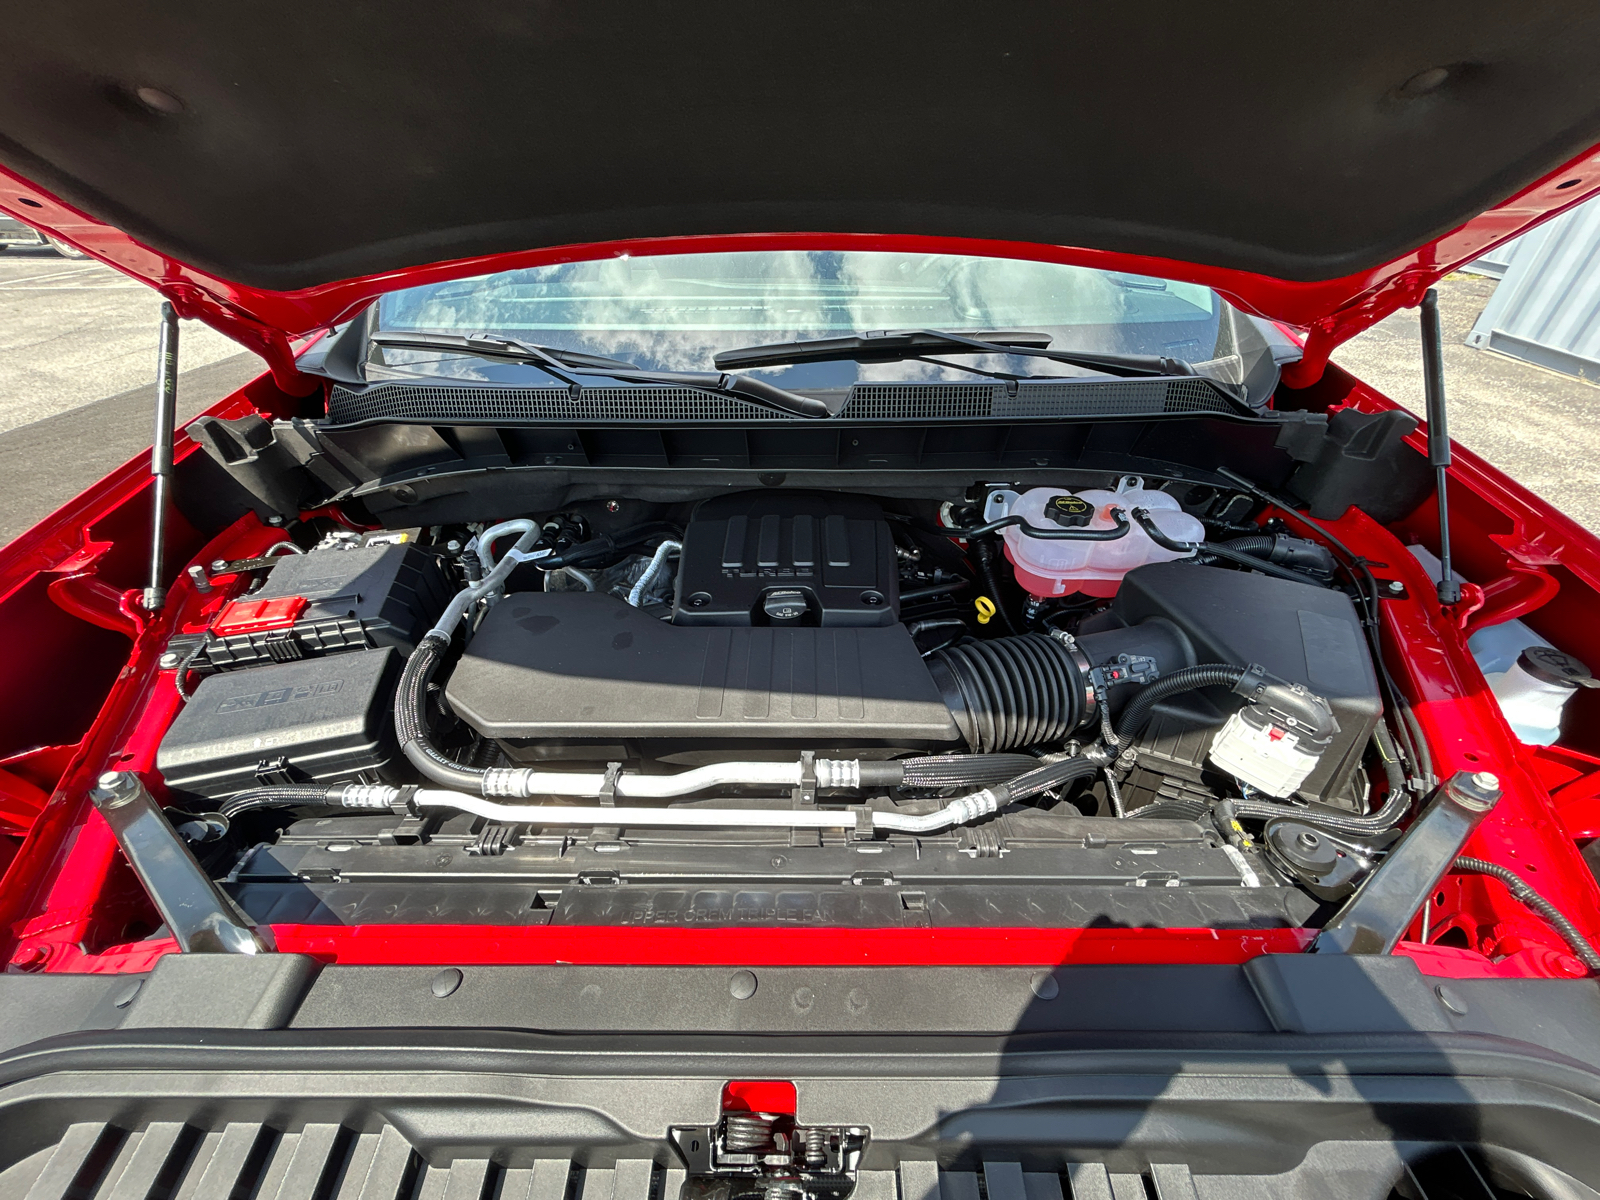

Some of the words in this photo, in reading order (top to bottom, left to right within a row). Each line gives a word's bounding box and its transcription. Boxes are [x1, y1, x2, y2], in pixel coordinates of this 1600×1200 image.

[620, 911, 678, 924] UPPER
[738, 907, 797, 921] TRIPLE
[802, 908, 835, 922] FAN
